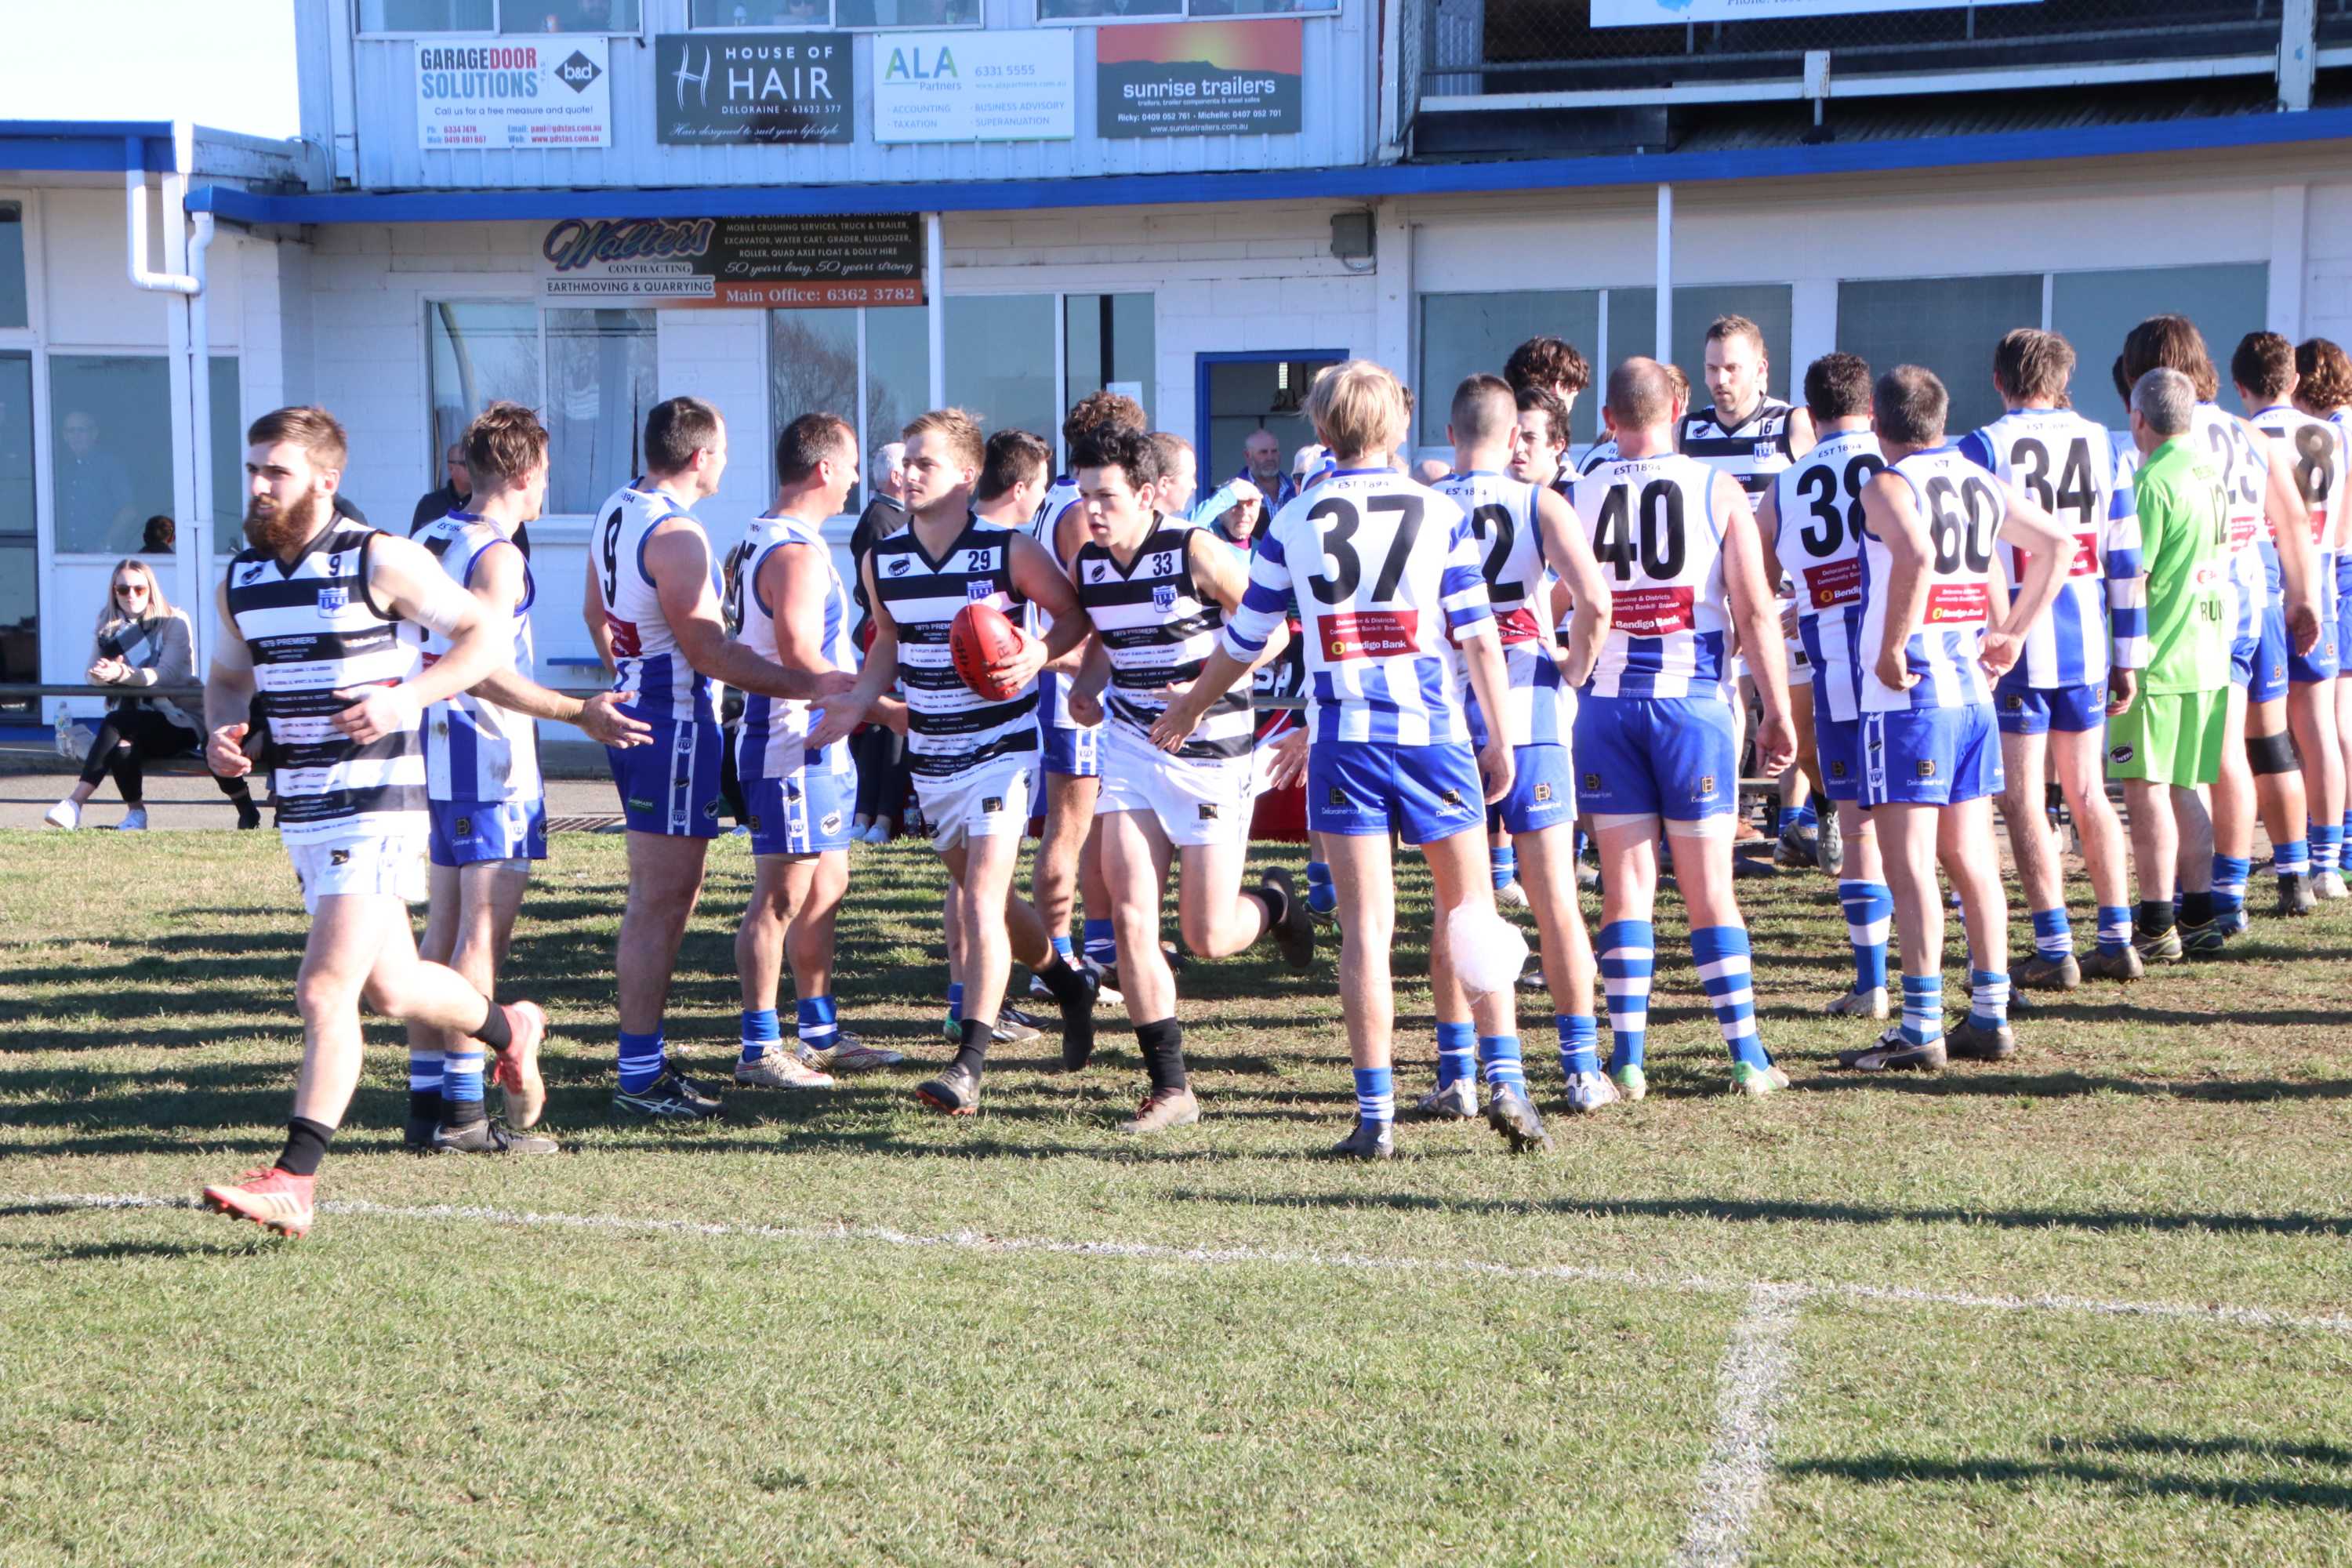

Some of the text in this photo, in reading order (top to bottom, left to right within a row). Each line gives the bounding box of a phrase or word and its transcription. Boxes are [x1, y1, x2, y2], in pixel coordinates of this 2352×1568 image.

[726, 46, 833, 60] HOUSE OF
[885, 46, 958, 79] ALA
[564, 62, 592, 79] b&d
[975, 64, 1036, 77] 6331 5555
[422, 71, 538, 99] SOLUTIONS
[728, 67, 833, 100] HAIR
[920, 81, 962, 92] Partners
[1123, 76, 1276, 98] sunrise trailers
[434, 107, 453, 116] Call
[455, 107, 463, 116] us
[465, 107, 476, 115] for
[487, 107, 504, 115] free
[546, 106, 563, 114] and
[565, 106, 593, 116] quote!
[721, 106, 780, 114] DELORAINE
[893, 104, 951, 114] ACCOUNTING
[975, 101, 1065, 112] BUSINESS ADVISORY
[1118, 113, 1140, 122] Ricky:
[1197, 111, 1230, 119] Michelle:
[1253, 110, 1267, 118] 052
[670, 122, 696, 137] Hair
[699, 123, 741, 140] designed
[743, 125, 752, 136] to
[754, 125, 774, 136] suit
[775, 127, 797, 141] your
[893, 119, 937, 129] TAXATION
[1150, 123, 1248, 133] www.sunrisetrailers.com.au
[727, 223, 756, 232] MOBILE
[757, 223, 798, 232] CRUSHING
[877, 221, 909, 230] TRAILER,
[543, 218, 713, 271] Walters
[724, 237, 772, 245] EXCAVATOR,
[775, 236, 800, 245] WATER
[771, 249, 795, 258] QUAD
[797, 249, 815, 257] AXLE
[844, 248, 850, 256] &
[879, 247, 898, 256] HIRE
[608, 263, 691, 274] CONTRACTING
[724, 261, 749, 273] 50
[751, 263, 781, 277] years
[815, 260, 840, 272] 50
[842, 263, 873, 276] years
[877, 260, 913, 274] strong
[547, 281, 712, 292] EARTHMOVING & QUARRYING
[727, 287, 914, 302] Main Office: 6362 3782
[1818, 448, 1835, 458] EST
[1613, 464, 1632, 475] EST
[1338, 481, 1357, 489] EST
[2011, 437, 2096, 524] 34
[1796, 453, 1886, 557] 38
[1594, 479, 1686, 581] 40
[1925, 475, 1999, 574] 60
[603, 506, 622, 608] 9
[1306, 495, 1425, 605] 37
[1472, 503, 1525, 602] 2
[328, 554, 341, 576] 9
[968, 550, 991, 572] 29
[1152, 552, 1173, 576] 33
[1616, 615, 1681, 630] Bendigo Bank
[1382, 640, 1407, 649] Bank
